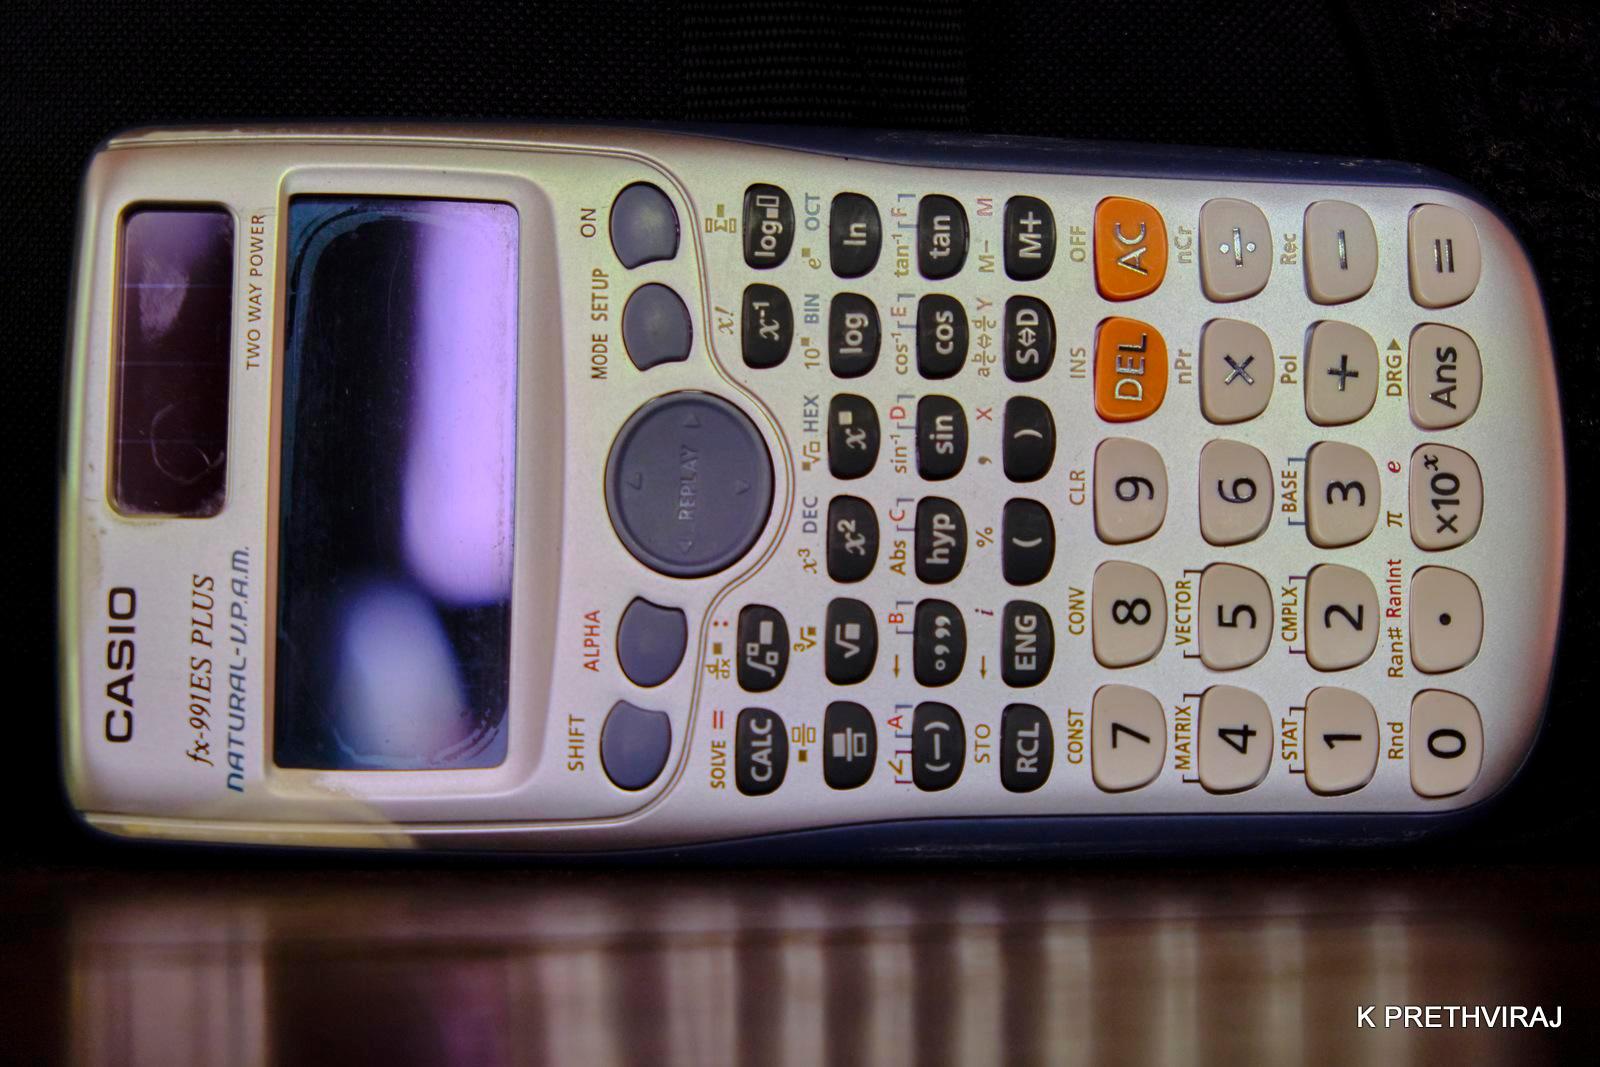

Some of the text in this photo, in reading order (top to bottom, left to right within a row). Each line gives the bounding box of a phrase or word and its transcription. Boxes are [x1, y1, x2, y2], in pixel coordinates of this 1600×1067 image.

[581, 207, 596, 238] ON
[805, 193, 820, 231] OCT
[892, 208, 906, 217] F
[976, 198, 992, 216] M
[843, 222, 867, 246] ln
[929, 215, 951, 259] tan
[1019, 211, 1042, 259] M+
[1070, 225, 1086, 263] OFF
[1115, 222, 1148, 275] AC
[1174, 226, 1192, 264] nCr
[1280, 233, 1297, 265] Rec
[1433, 239, 1455, 273] =
[245, 214, 266, 371] TWO WAY POWER
[592, 268, 609, 321] SETUP
[804, 293, 820, 324] BIN
[976, 297, 992, 311] Y
[715, 306, 734, 335] x!
[891, 307, 906, 317] E
[839, 312, 869, 355] log
[935, 310, 954, 355] cos
[592, 334, 608, 380] MODE
[1069, 347, 1086, 379] INS
[1115, 333, 1147, 401] DEL
[1175, 349, 1192, 385] nPr
[1280, 355, 1297, 385] Pol
[1327, 355, 1359, 392] +
[1386, 355, 1402, 397] DRG
[1428, 346, 1458, 410] Ans
[804, 394, 819, 432] HEX
[890, 406, 906, 420] D
[976, 407, 992, 421] X
[929, 415, 954, 454] sin
[678, 445, 698, 521] REPLAY
[1387, 460, 1401, 473] e
[1069, 470, 1086, 506] CLR
[1115, 475, 1154, 502] 9
[1218, 477, 1256, 504] 6
[1281, 471, 1297, 513] BASE
[1326, 480, 1366, 507] 3
[802, 496, 818, 534] DEC
[890, 510, 905, 522] C
[1386, 511, 1403, 528] π
[926, 513, 954, 564] hyp
[976, 527, 993, 548] %
[890, 540, 906, 576] Abs
[1386, 559, 1401, 618] RanInt
[888, 613, 903, 624] B
[1068, 586, 1085, 635] CONV
[1112, 598, 1151, 626] 8
[1176, 580, 1191, 645] VECTOR
[1217, 604, 1256, 629] 5
[1281, 586, 1298, 642] CMPLX
[1324, 604, 1363, 631] 2
[583, 610, 600, 672] ALPHA
[1014, 615, 1037, 671] ENG
[1387, 627, 1404, 678] Ran#
[105, 586, 136, 744] CASIO
[186, 574, 215, 767] fx-991ES PLUS
[887, 715, 902, 729] A
[1068, 708, 1084, 764] CONST
[1112, 722, 1150, 749] 7
[1175, 705, 1191, 770] MATRIX
[1218, 724, 1256, 754] 4
[1281, 718, 1297, 761] STAT
[1387, 722, 1404, 760] Rnd
[568, 714, 585, 772] SHIFT
[750, 718, 773, 782] CALC
[974, 724, 991, 764] STO
[1016, 722, 1040, 773] RCL
[1323, 734, 1362, 750] 1
[1427, 728, 1466, 760] 0
[711, 740, 726, 789] SOLVE
